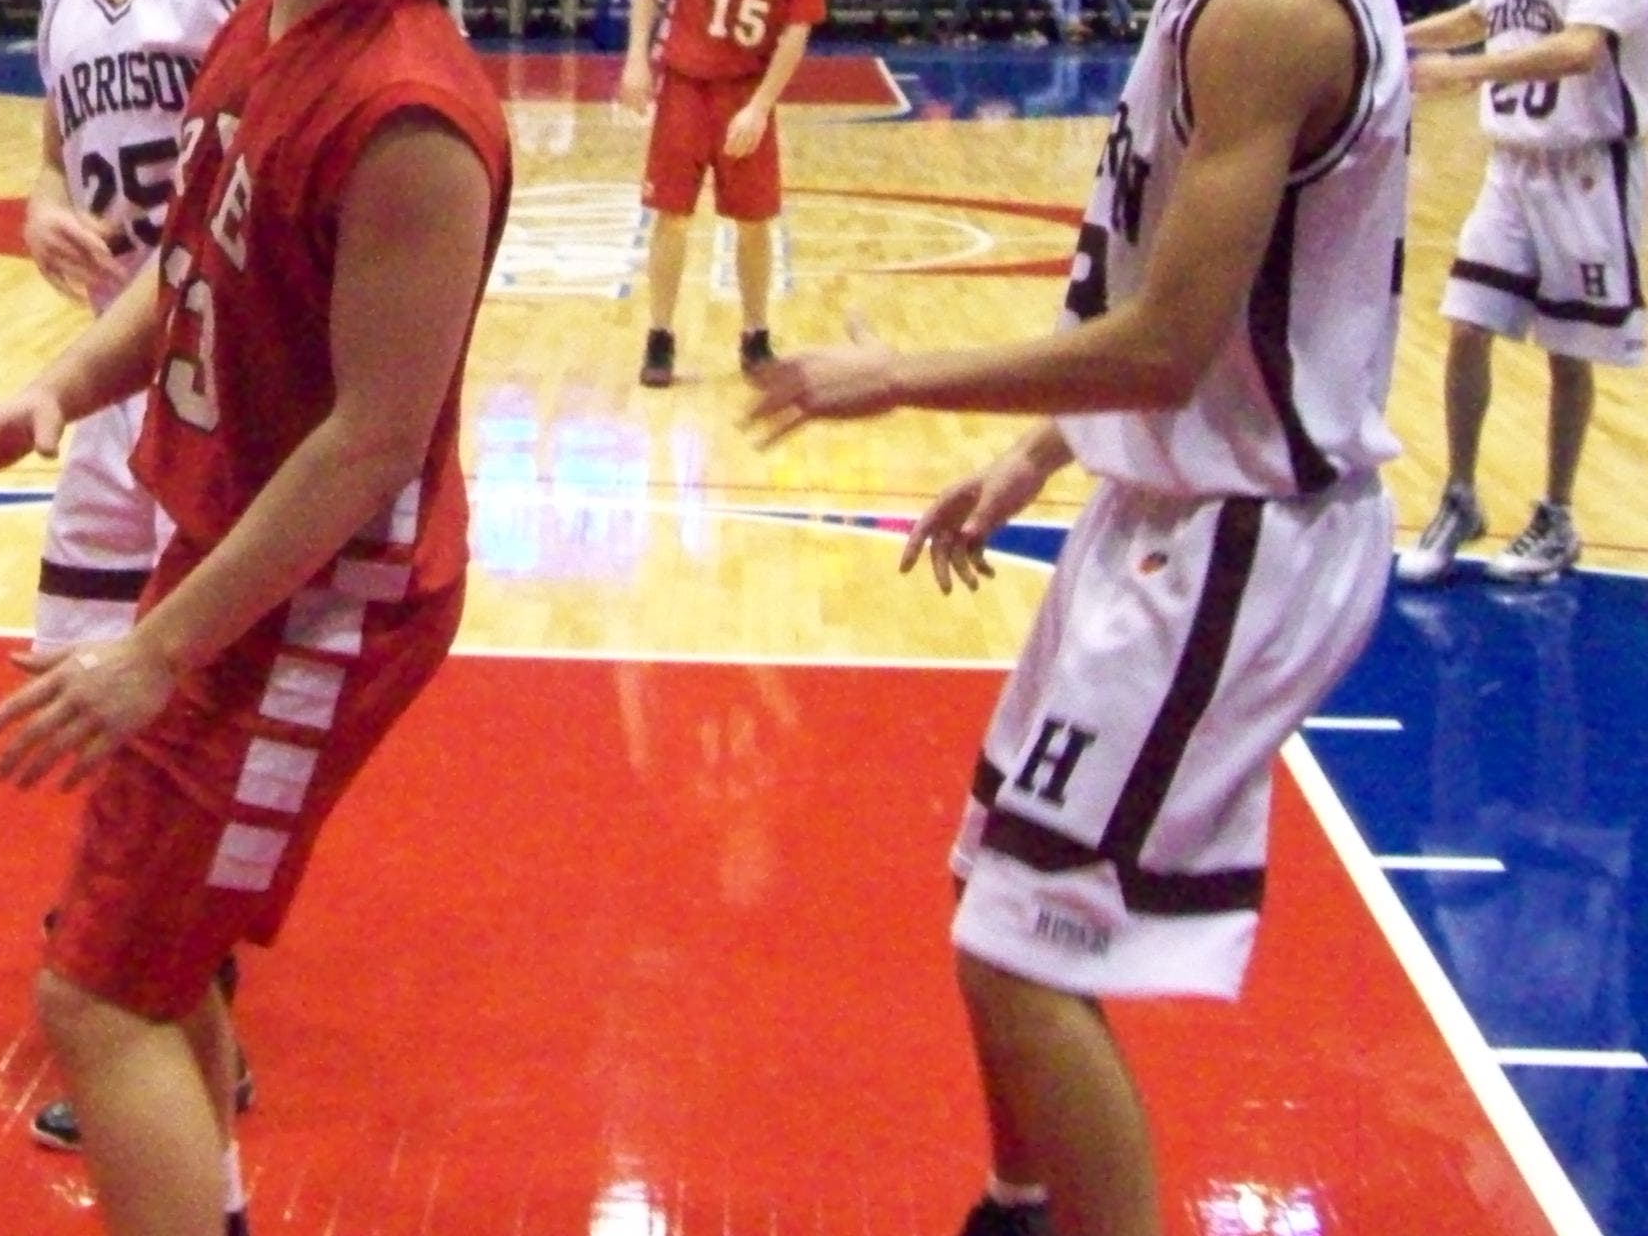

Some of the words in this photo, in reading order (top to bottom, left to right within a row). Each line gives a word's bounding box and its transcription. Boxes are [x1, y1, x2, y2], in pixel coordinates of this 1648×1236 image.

[59, 51, 202, 138] ARRISON
[1579, 263, 1607, 298] H
[1013, 718, 1097, 809] H
